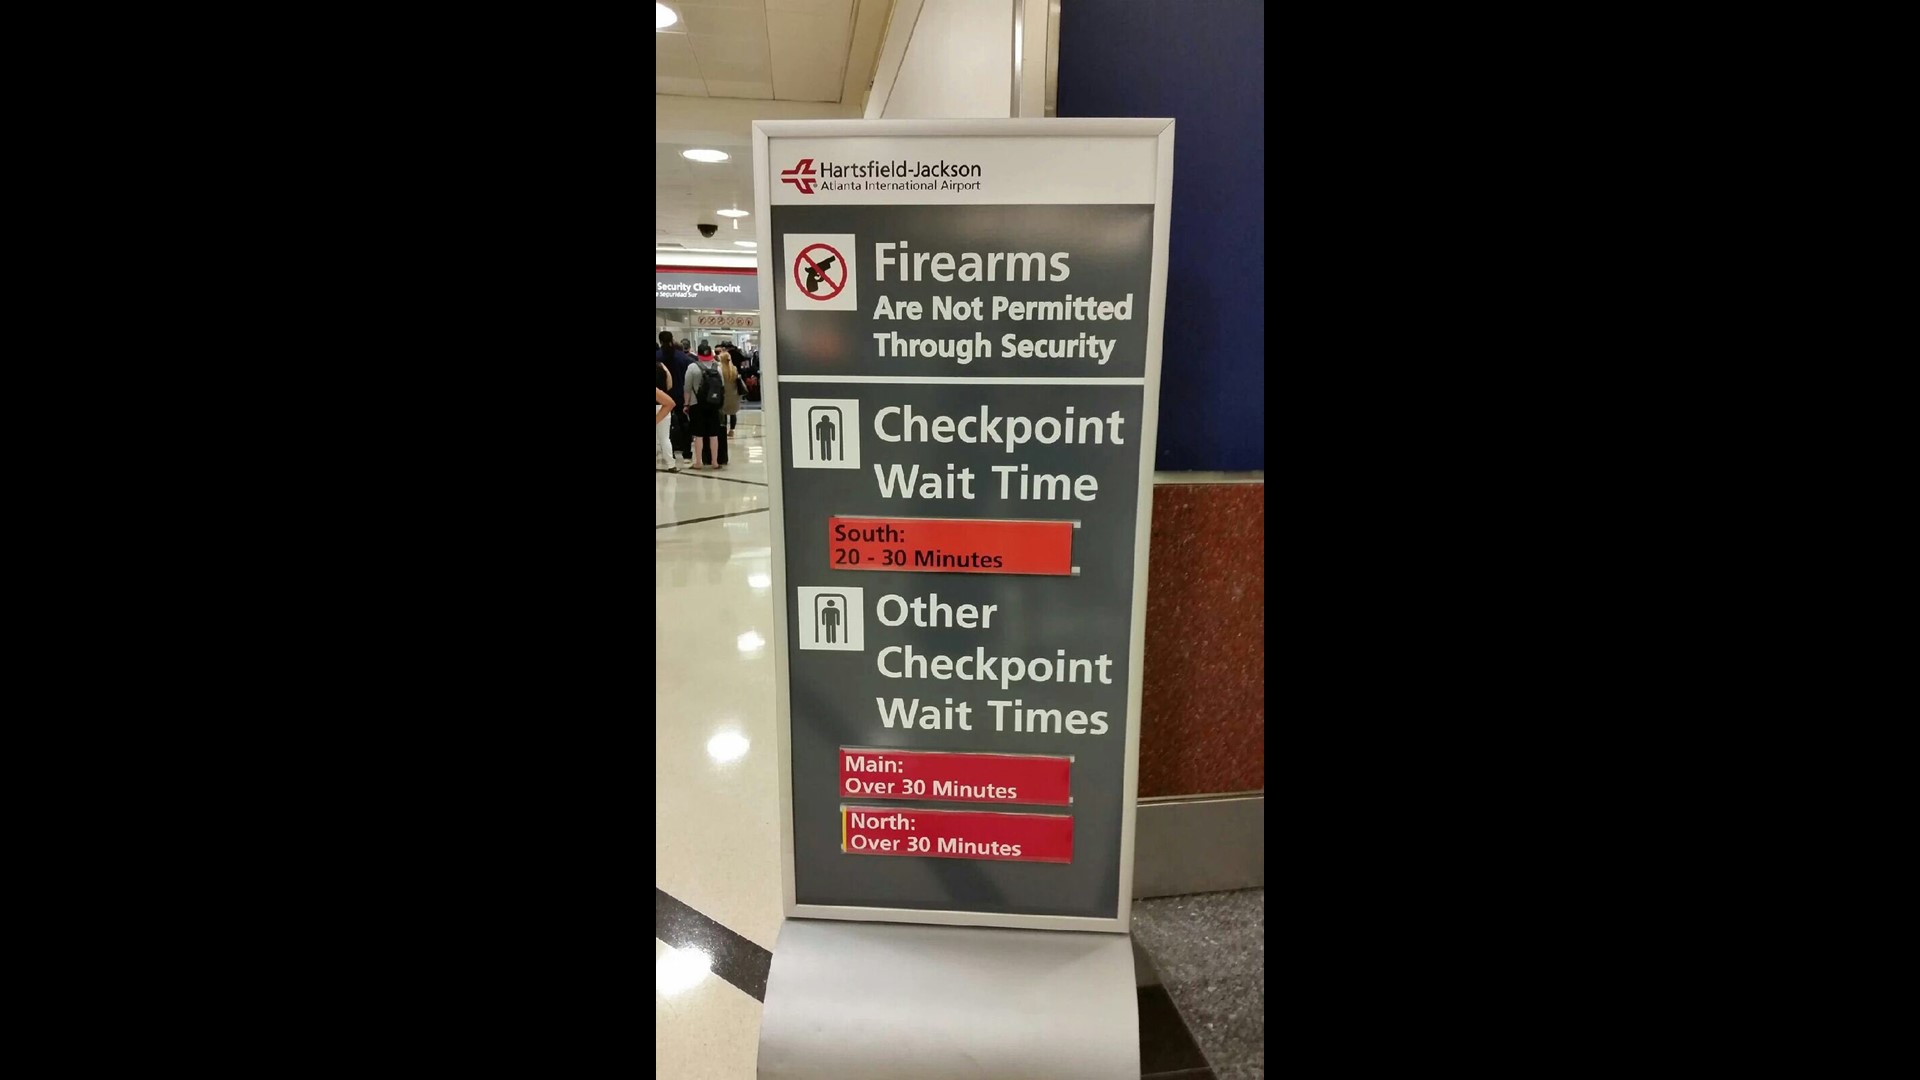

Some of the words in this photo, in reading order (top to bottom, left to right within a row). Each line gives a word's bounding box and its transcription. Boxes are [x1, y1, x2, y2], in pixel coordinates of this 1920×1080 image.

[820, 159, 982, 179] Hartsfield-Jackson
[820, 180, 862, 192] Atlanta
[865, 180, 938, 192] International
[940, 180, 982, 194] Airport
[875, 240, 1071, 283] Firearms
[657, 282, 691, 293] Security
[692, 283, 742, 294] Checkpoint
[872, 295, 923, 321] Are
[932, 295, 984, 321] Not
[991, 293, 1134, 321] Permitted
[872, 331, 992, 365] Through
[1001, 332, 1117, 365] Security
[873, 404, 1125, 454] Checkpoint
[873, 463, 975, 500] Wait
[991, 463, 1099, 502] Time
[834, 523, 905, 543] South:
[835, 547, 860, 565] 20
[881, 548, 907, 567] 30
[914, 549, 1003, 569] Minutes
[876, 592, 998, 629] Other
[876, 644, 1113, 690] Checkpoint
[875, 697, 973, 731] Wait
[987, 698, 1109, 735] Times
[845, 755, 903, 774] Main:
[845, 777, 896, 794] Over
[901, 778, 926, 795] 30
[932, 780, 1017, 799] Minutes
[851, 812, 916, 831] North:
[851, 834, 901, 851] Over
[907, 836, 931, 853] 30
[937, 837, 1022, 857] Minutes
